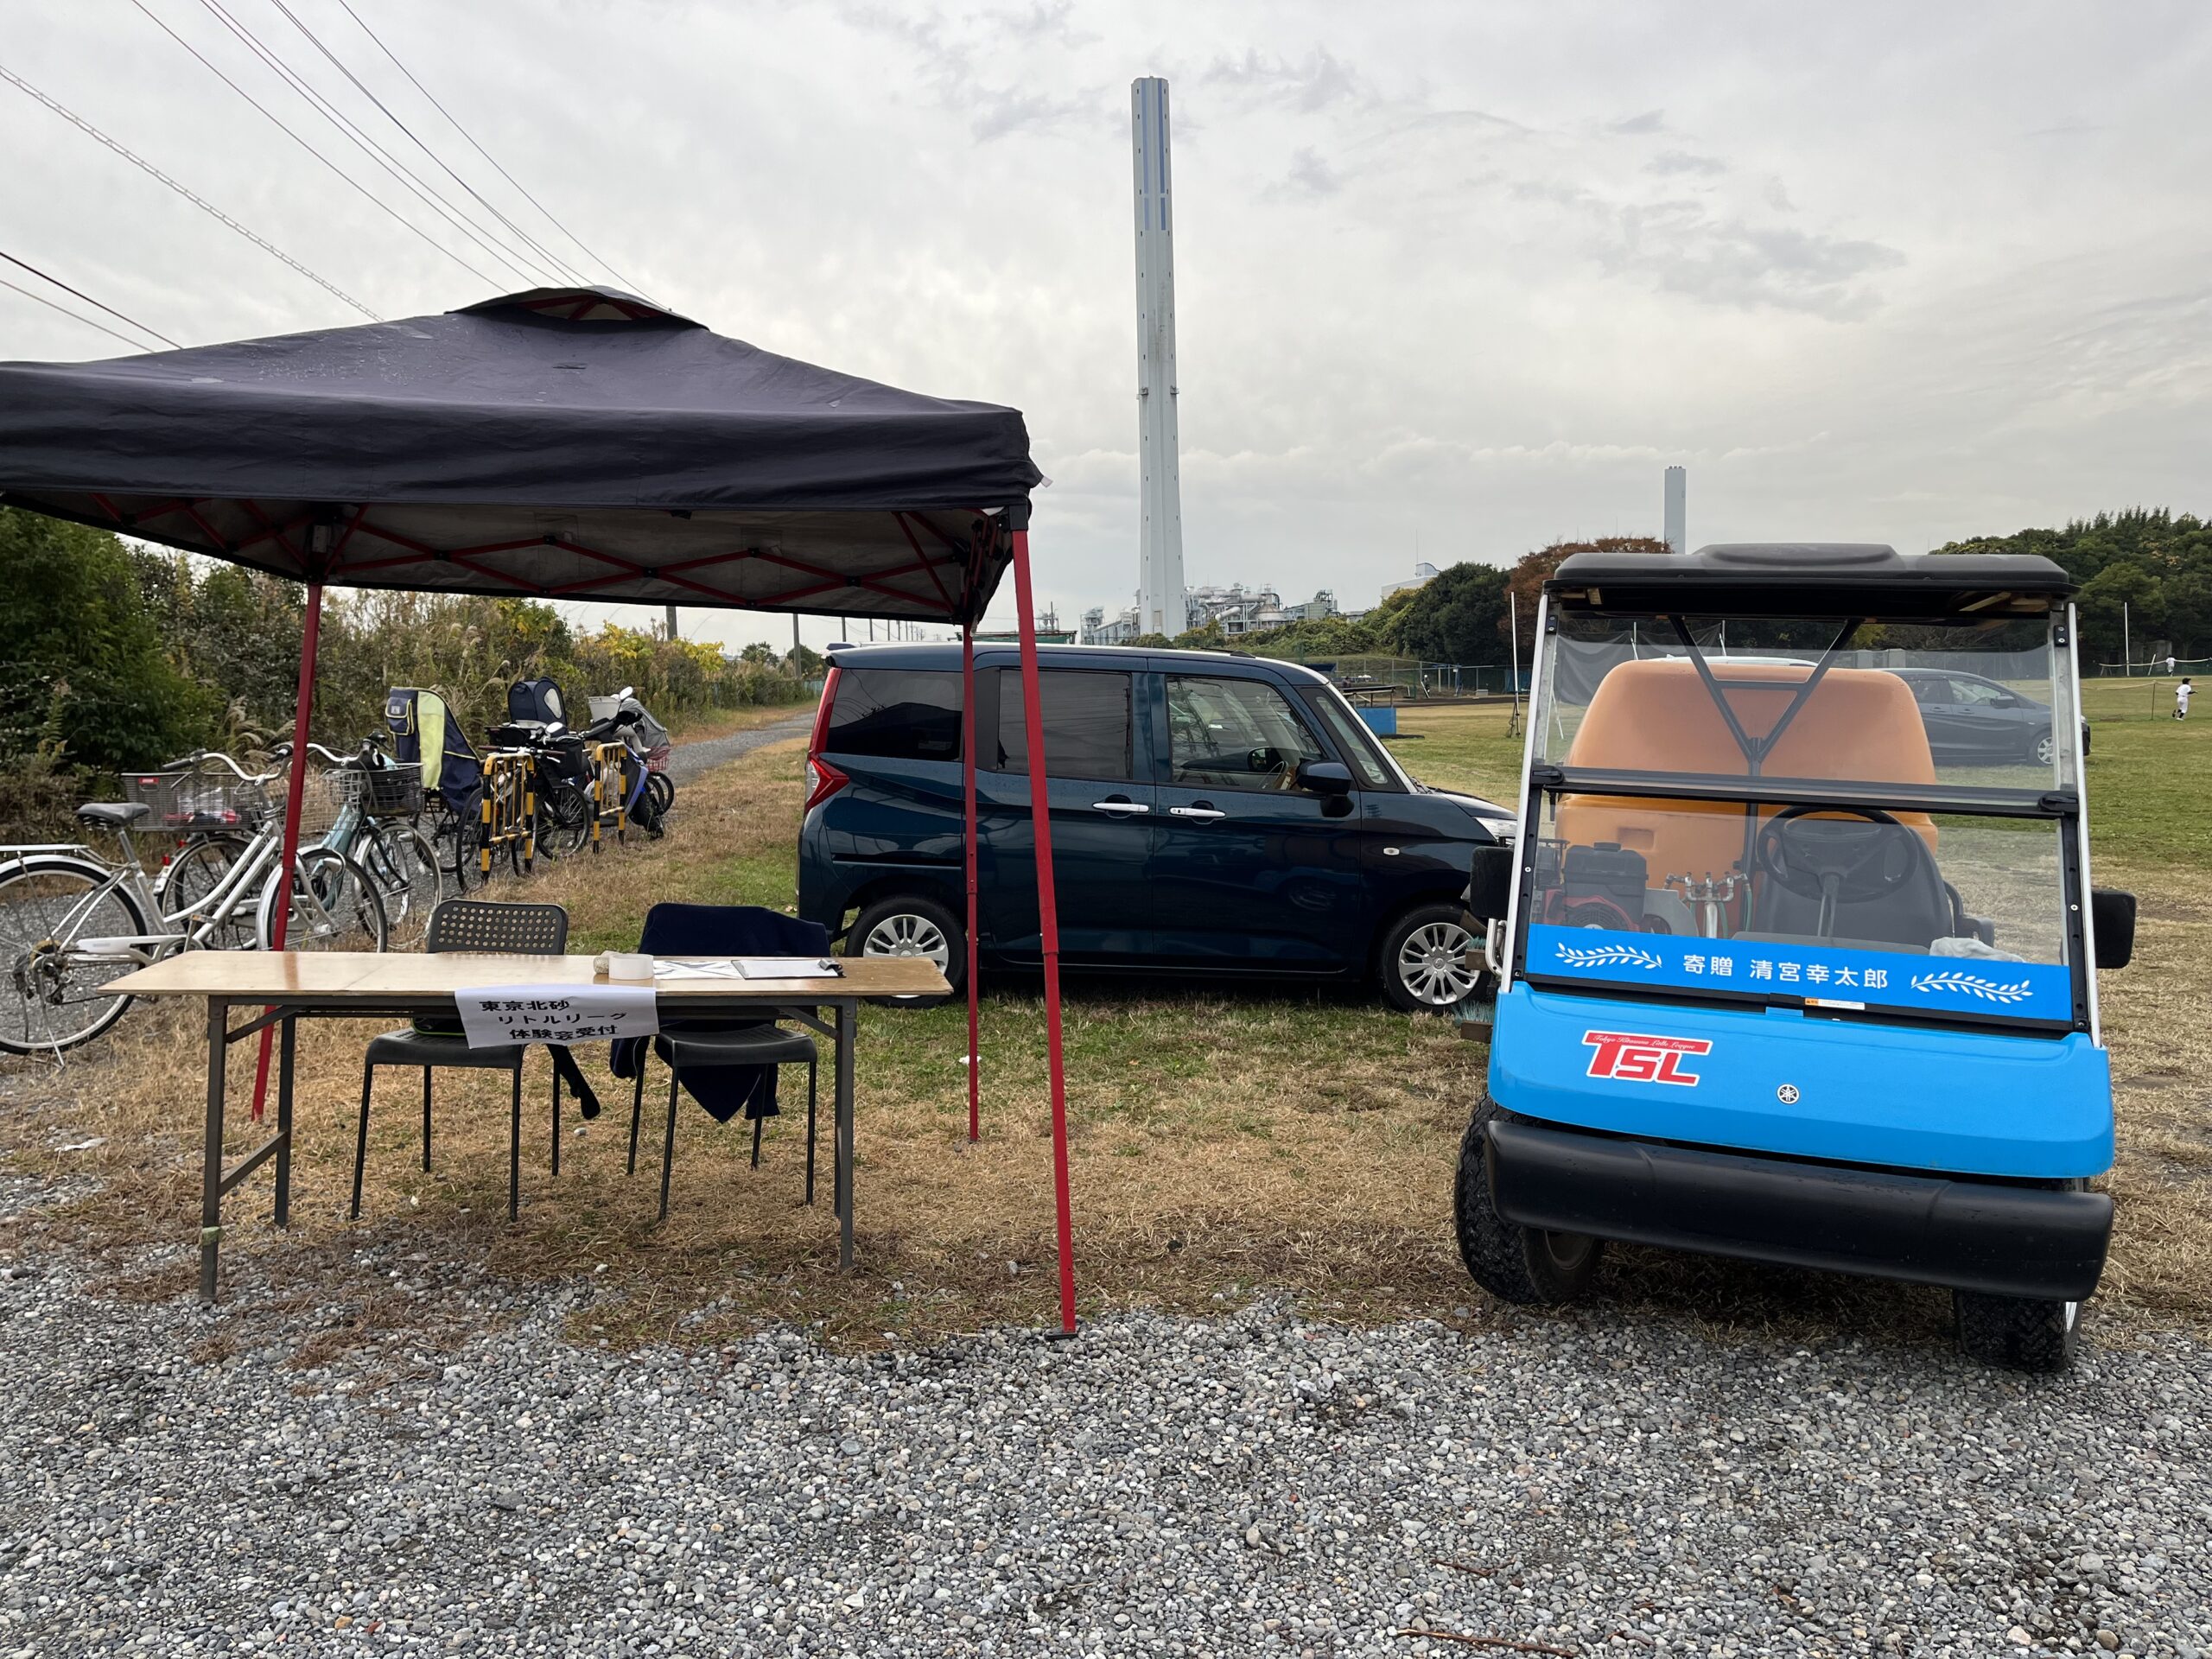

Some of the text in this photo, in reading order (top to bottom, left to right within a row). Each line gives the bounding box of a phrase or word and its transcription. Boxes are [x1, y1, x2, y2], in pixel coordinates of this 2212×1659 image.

[1683, 955, 1888, 989] 寄贈 清宮幸太郎
[478, 1000, 570, 1013] 東京北砂
[498, 1012, 628, 1026] リトルリーグ
[509, 1024, 619, 1041] 体験会受付
[1583, 1031, 1713, 1086] TSL
